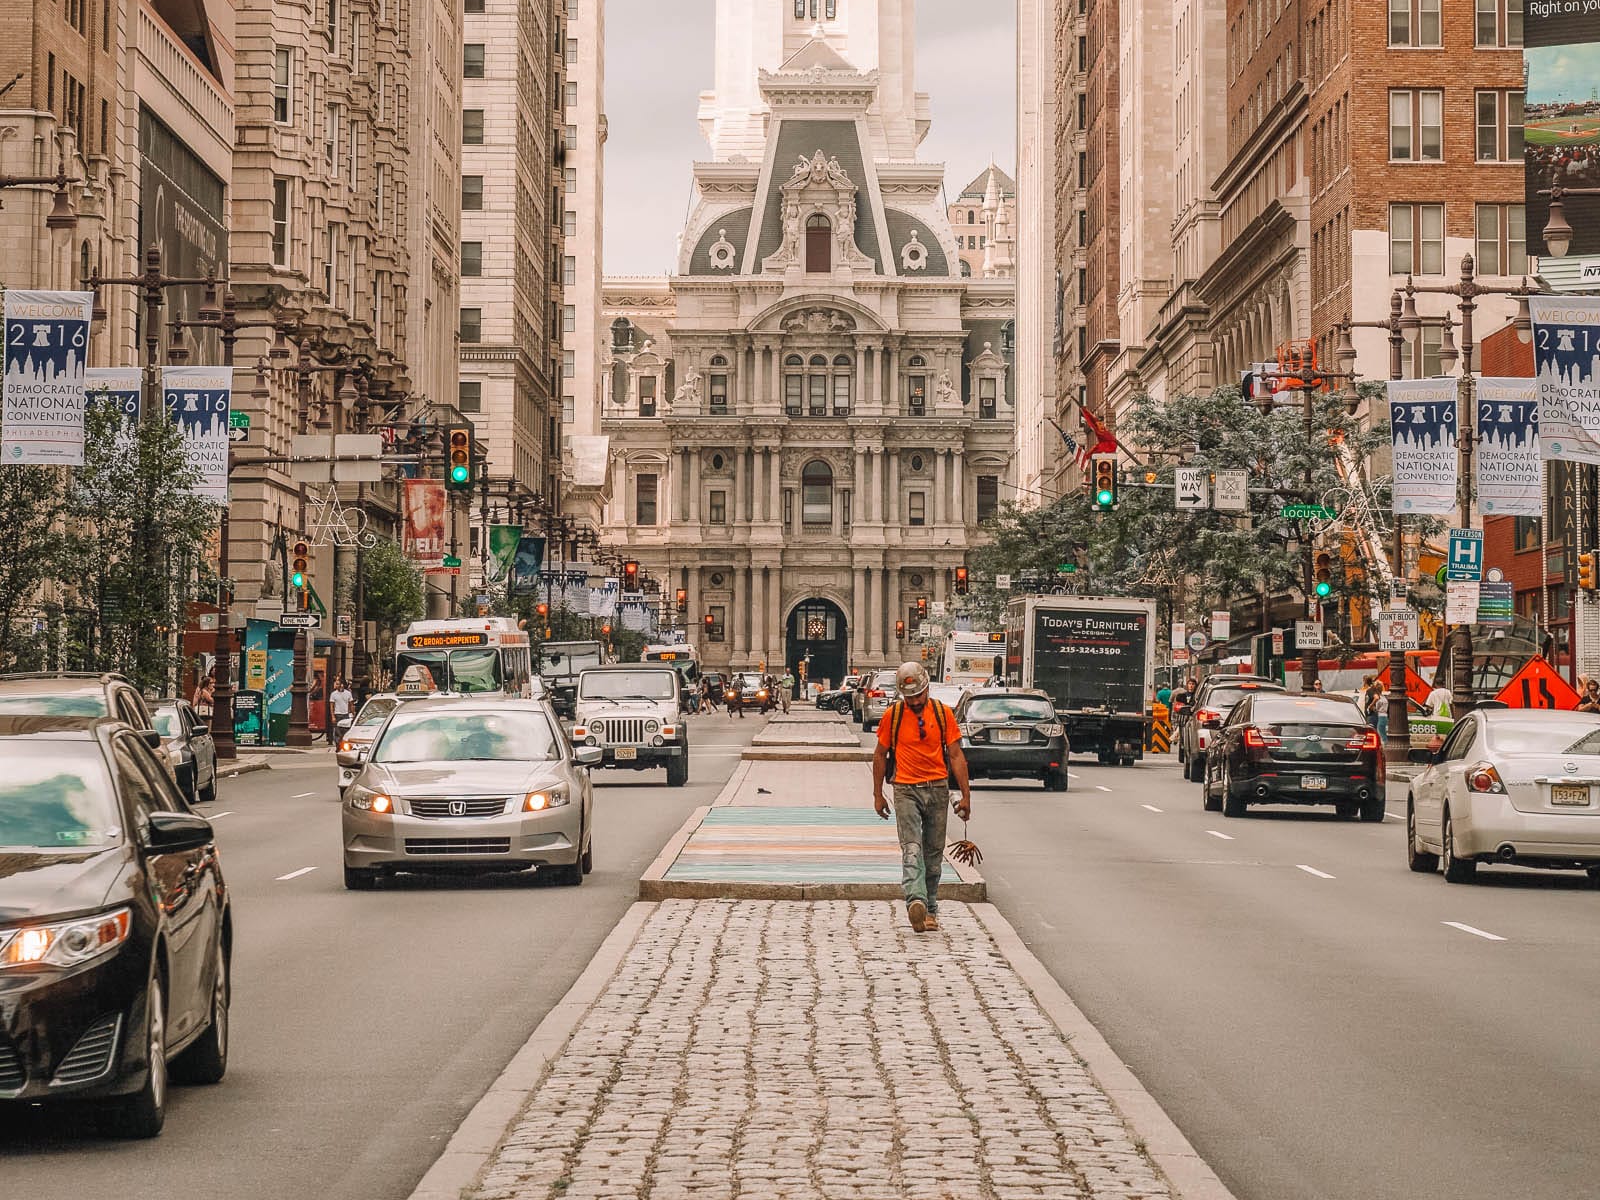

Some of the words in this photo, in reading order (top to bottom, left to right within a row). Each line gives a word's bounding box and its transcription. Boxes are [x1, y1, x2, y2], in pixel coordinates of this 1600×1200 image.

[1530, 0, 1561, 18] Right
[1564, 1, 1580, 12] on
[13, 304, 85, 318] WELCOME
[167, 377, 225, 388] WELCOME
[8, 384, 84, 396] DEMOCRATIC
[1391, 390, 1452, 401] WELCOME
[7, 397, 82, 410] NATIONAL
[7, 411, 82, 422] CONVENTION
[1395, 451, 1455, 460] DEMOCRATIC
[1480, 451, 1539, 460] DEMOCRATIC
[1396, 461, 1455, 471] NATIONAL
[1480, 462, 1539, 473] NATIONAL
[1181, 471, 1202, 481] ONE
[1397, 472, 1455, 481] CONVENTION
[1480, 473, 1539, 482] CONVENTION
[1181, 483, 1202, 492] WAY
[1283, 509, 1323, 518] LOCUST
[1450, 529, 1482, 538] JEFFERSON
[1455, 540, 1477, 563] H
[1398, 613, 1416, 621] BLOCK
[1085, 618, 1140, 631] FURNITURE
[412, 636, 424, 647] 32
[424, 635, 481, 646] BROAD-CARPENTER
[1400, 641, 1416, 649] BOX
